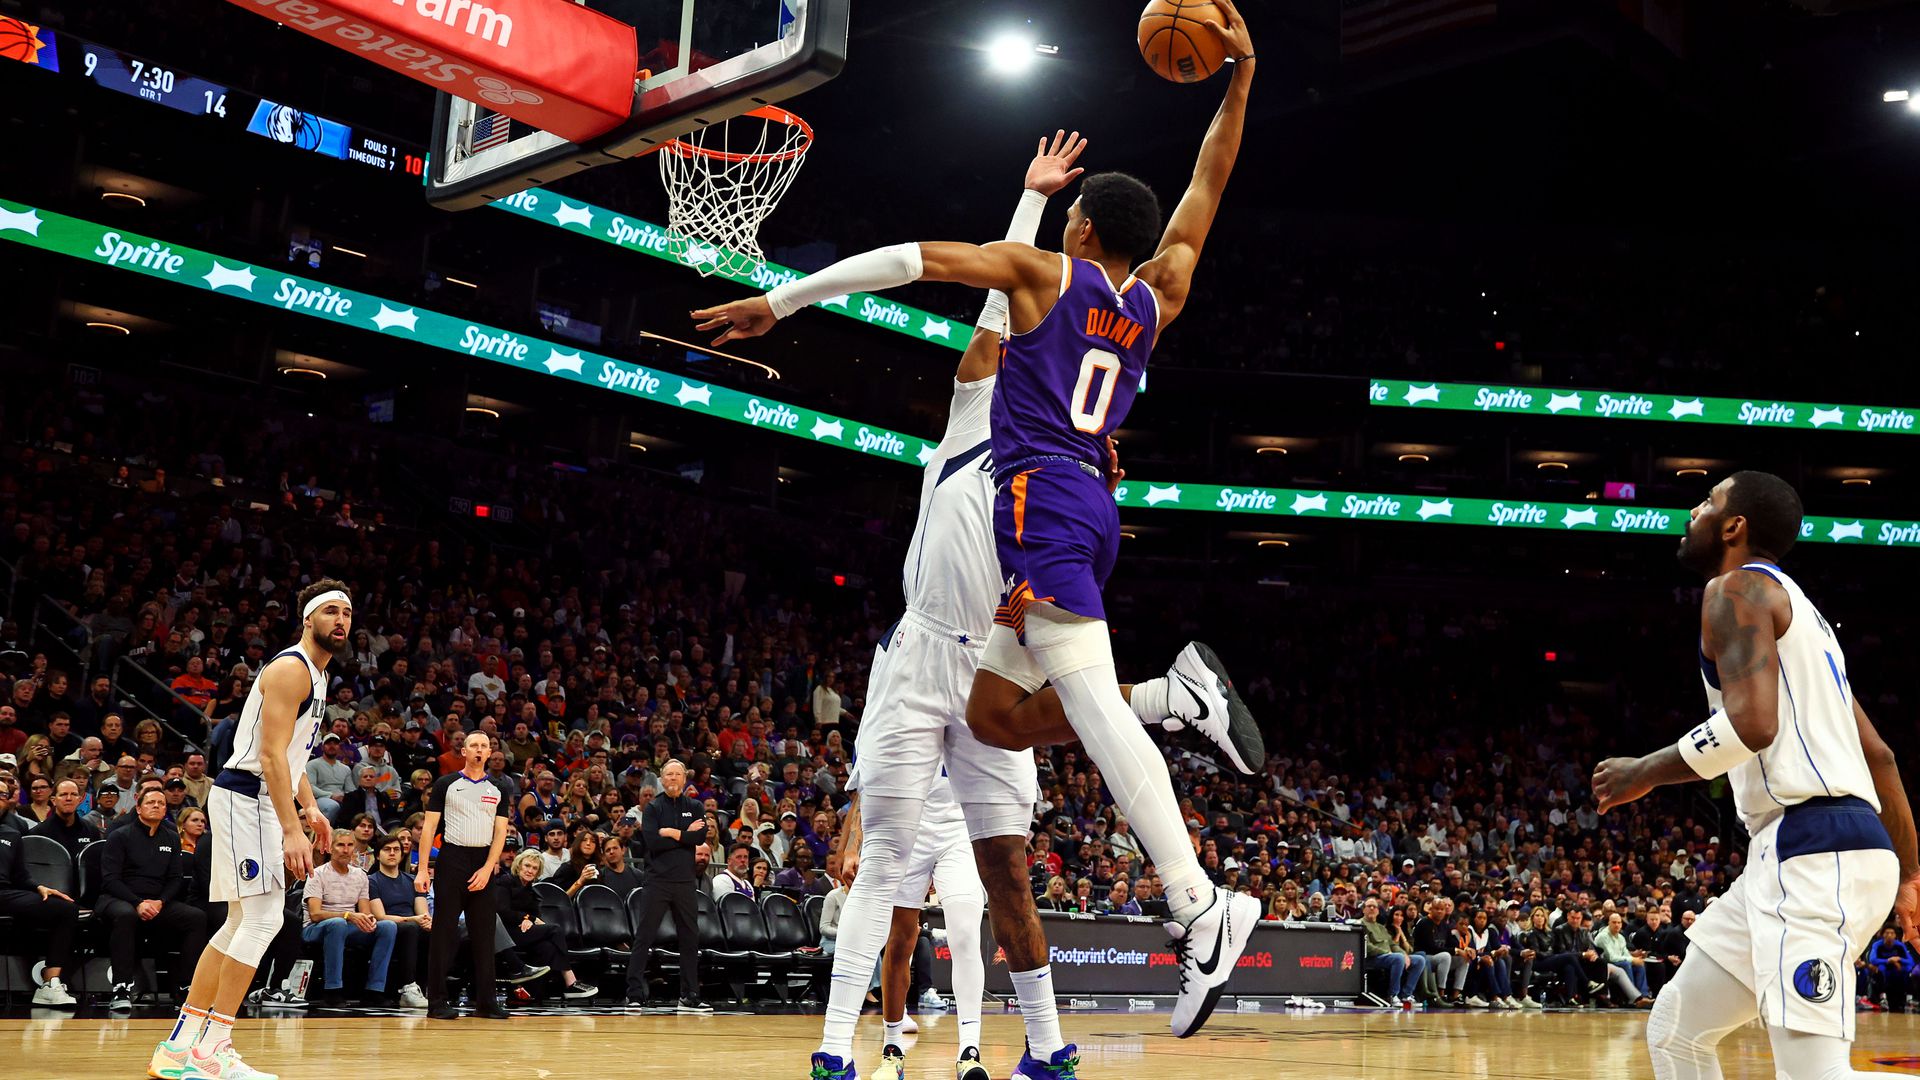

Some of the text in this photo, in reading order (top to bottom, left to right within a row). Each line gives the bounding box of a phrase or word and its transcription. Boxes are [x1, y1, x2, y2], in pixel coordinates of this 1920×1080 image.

[392, 0, 513, 47] arm
[84, 53, 98, 76] 9
[131, 60, 174, 93] 7:30
[140, 87, 162, 101] QTR 1
[204, 90, 226, 118] 14
[348, 148, 395, 171] TIMEOUTS 7
[364, 138, 396, 157] FOULS 1
[404, 155, 423, 176] 10
[606, 217, 667, 252] Sprite
[859, 297, 909, 328] Sprite
[1085, 307, 1144, 349] DUNN
[94, 231, 905, 456] Sprite Sprite Sprite Sprite Sprite Sprite
[1070, 348, 1121, 435] 0
[1473, 387, 1914, 432] Sprite Sprite Sprite Sprite
[1215, 488, 1276, 512] Sprite
[1341, 495, 1401, 518] Sprite
[1487, 502, 1547, 526] Sprite
[1611, 509, 1670, 532] Sprite
[1049, 947, 1106, 967] Footprint
[1107, 947, 1149, 965] Center
[1256, 951, 1273, 968] 5G
[1299, 955, 1334, 969] verizon
